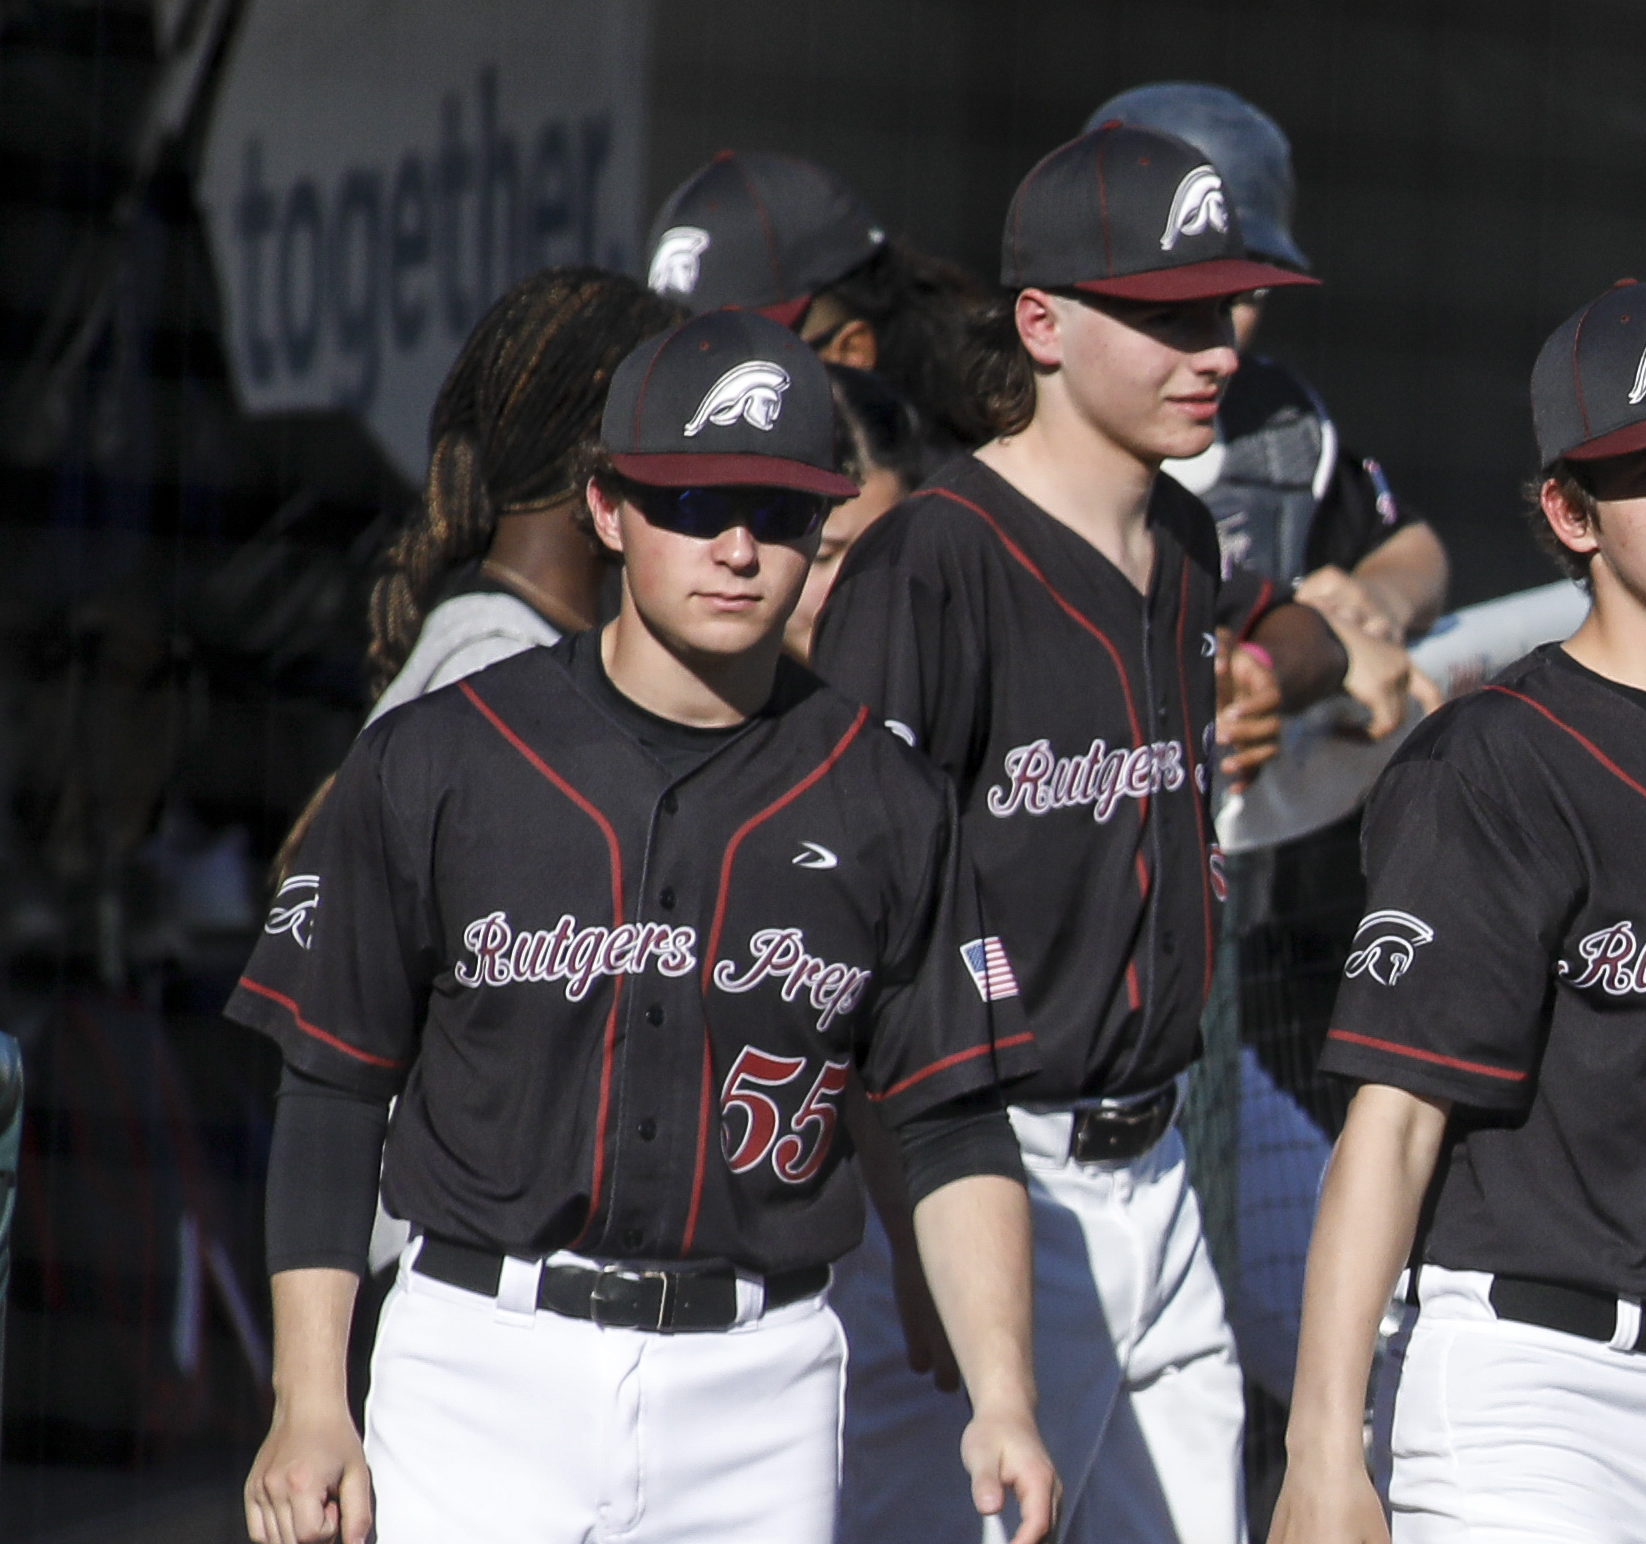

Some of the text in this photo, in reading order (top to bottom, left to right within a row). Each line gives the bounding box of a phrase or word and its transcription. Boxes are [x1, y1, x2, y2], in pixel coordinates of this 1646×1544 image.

[987, 738, 1185, 824] Rutgers
[455, 910, 872, 1032] Rutgers Prep
[719, 1044, 850, 1185] 55
